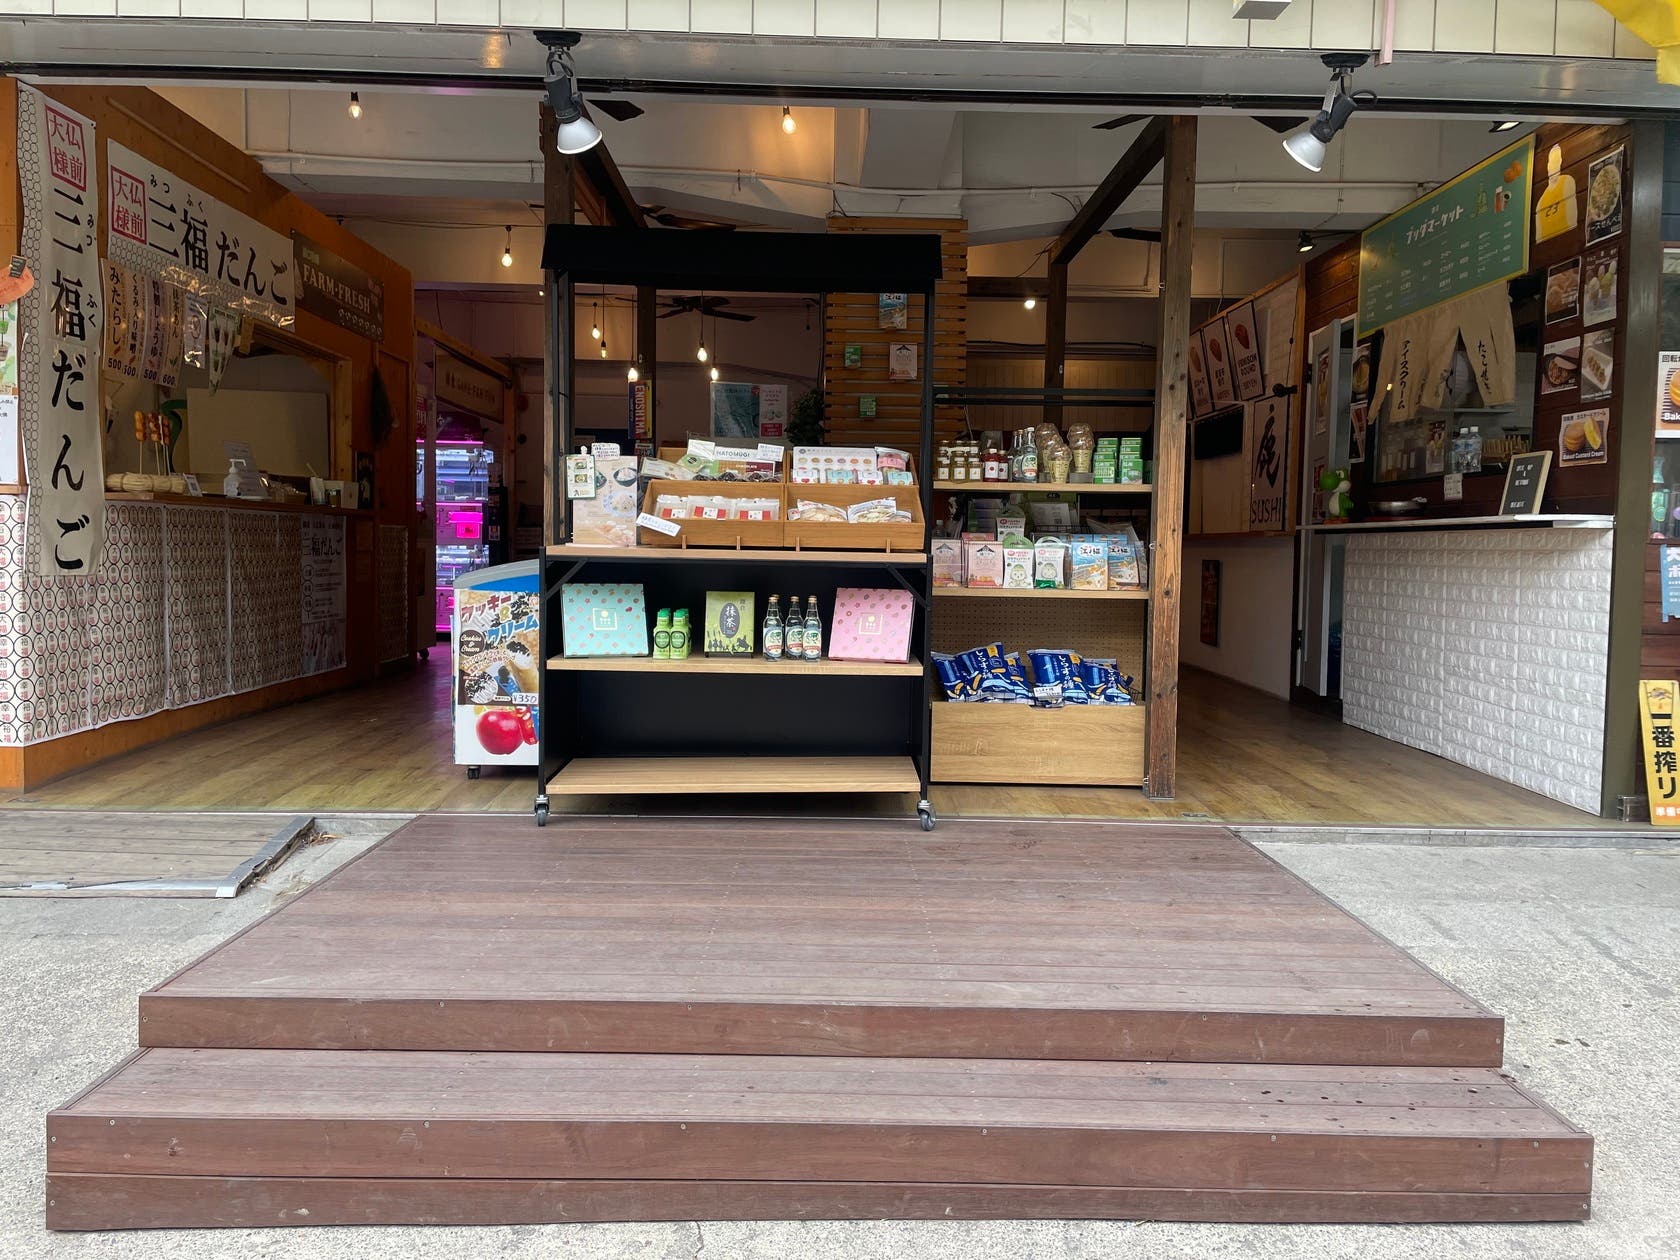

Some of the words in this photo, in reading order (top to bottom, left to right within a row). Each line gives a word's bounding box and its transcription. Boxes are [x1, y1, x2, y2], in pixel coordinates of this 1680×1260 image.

[148, 194, 289, 306] 三福だんご
[110, 267, 122, 345] みたらし
[51, 187, 90, 570] 三福だんご
[108, 358, 123, 371] 500
[143, 368, 159, 381] 500
[162, 373, 177, 387] 600
[635, 385, 646, 434] ENOSHIMA
[1251, 497, 1281, 524] SUSHI
[461, 594, 512, 621] クッキー
[725, 605, 736, 628] 抹茶
[486, 613, 540, 646] クリーム
[1650, 713, 1678, 799] 一番搾り
